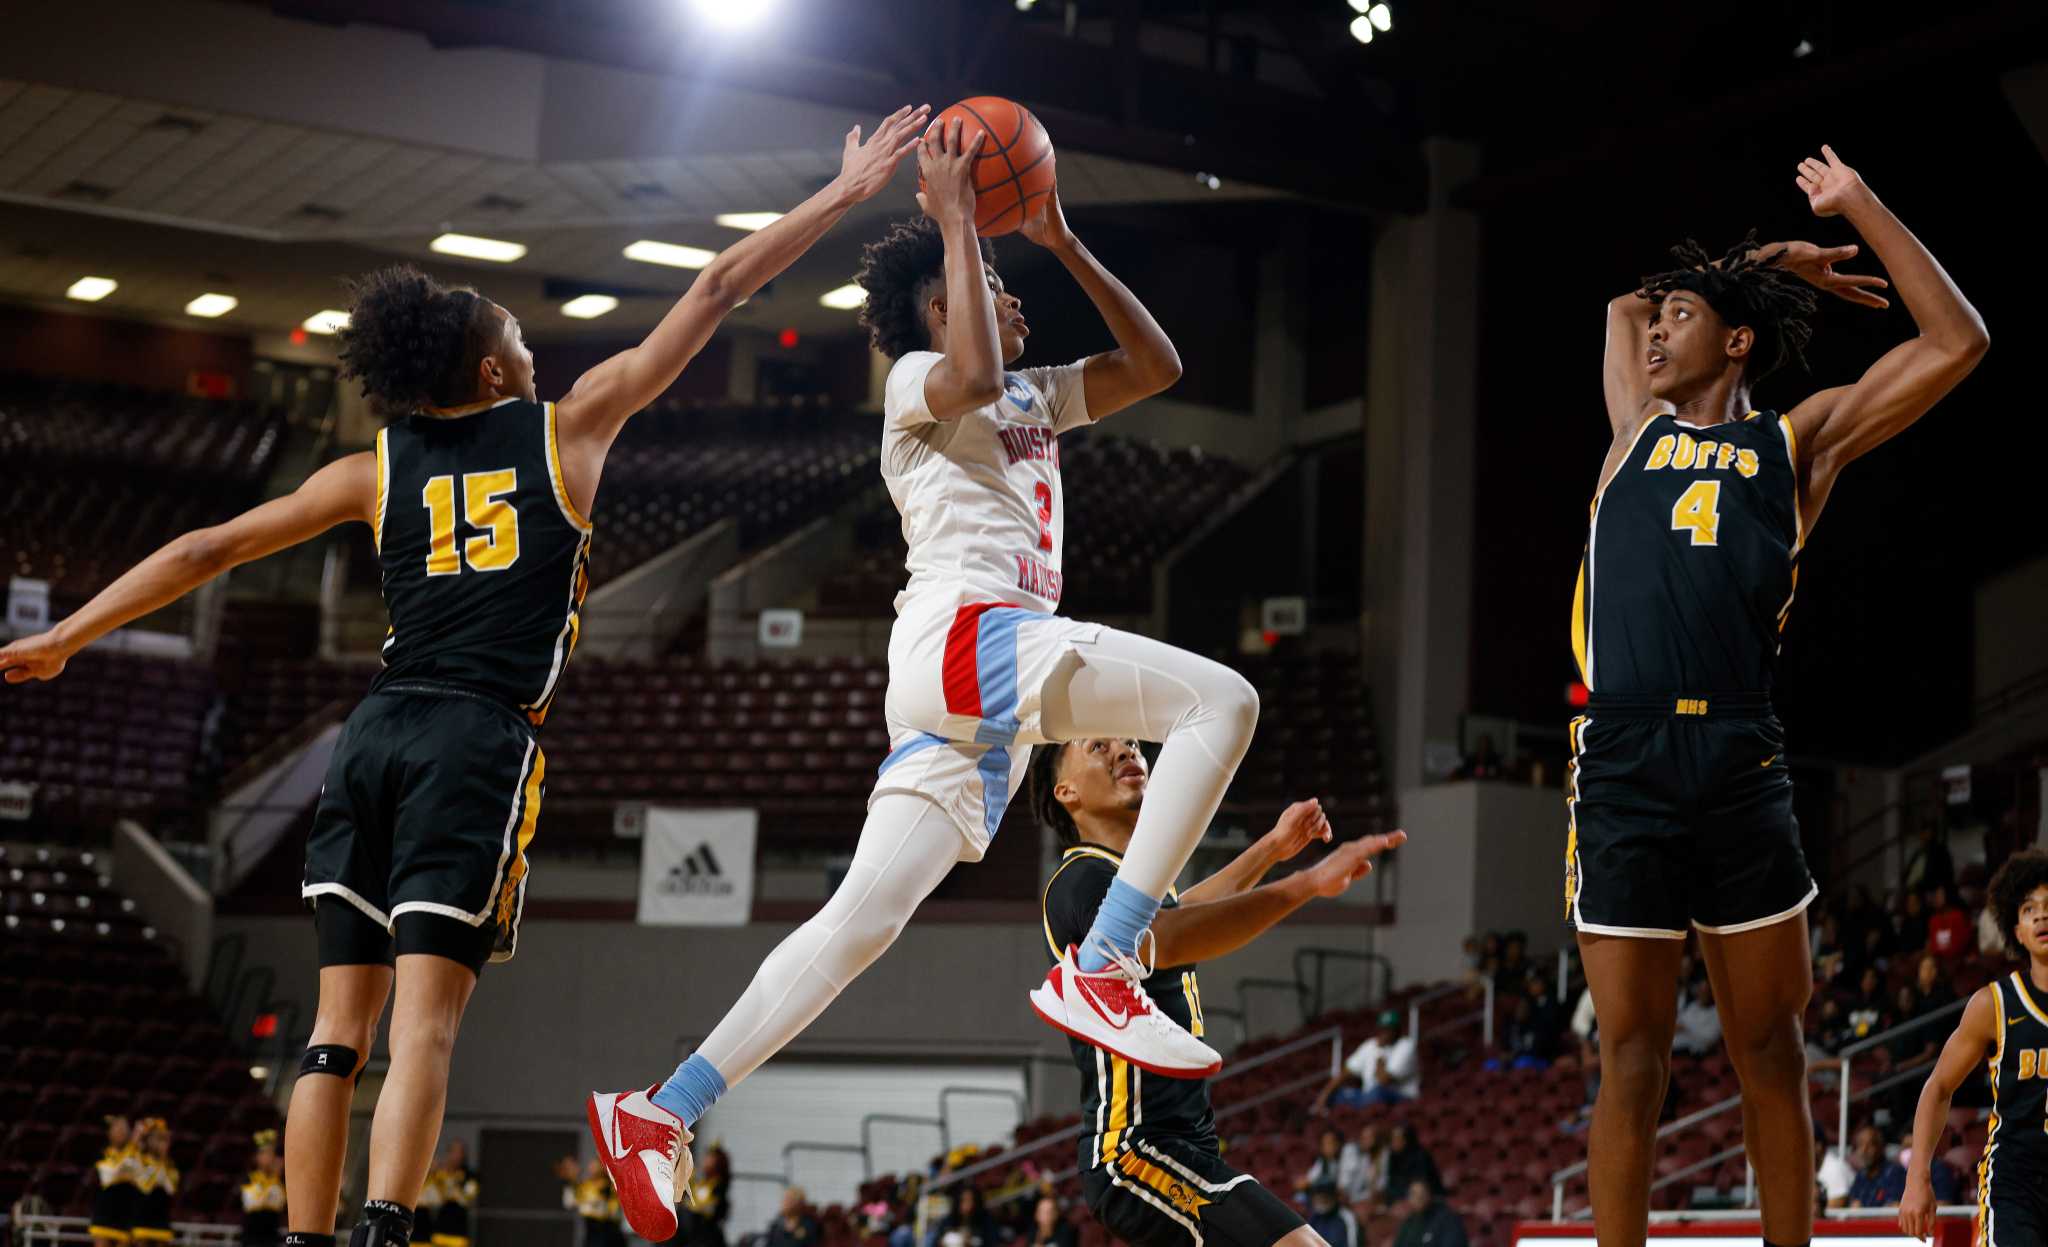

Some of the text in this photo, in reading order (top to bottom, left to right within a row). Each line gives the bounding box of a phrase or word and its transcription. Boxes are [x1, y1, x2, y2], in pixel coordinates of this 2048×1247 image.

[1643, 432, 1760, 478] BUFFS
[422, 466, 520, 577] 15
[1670, 480, 1721, 546] 4
[1675, 699, 1708, 715] MHS
